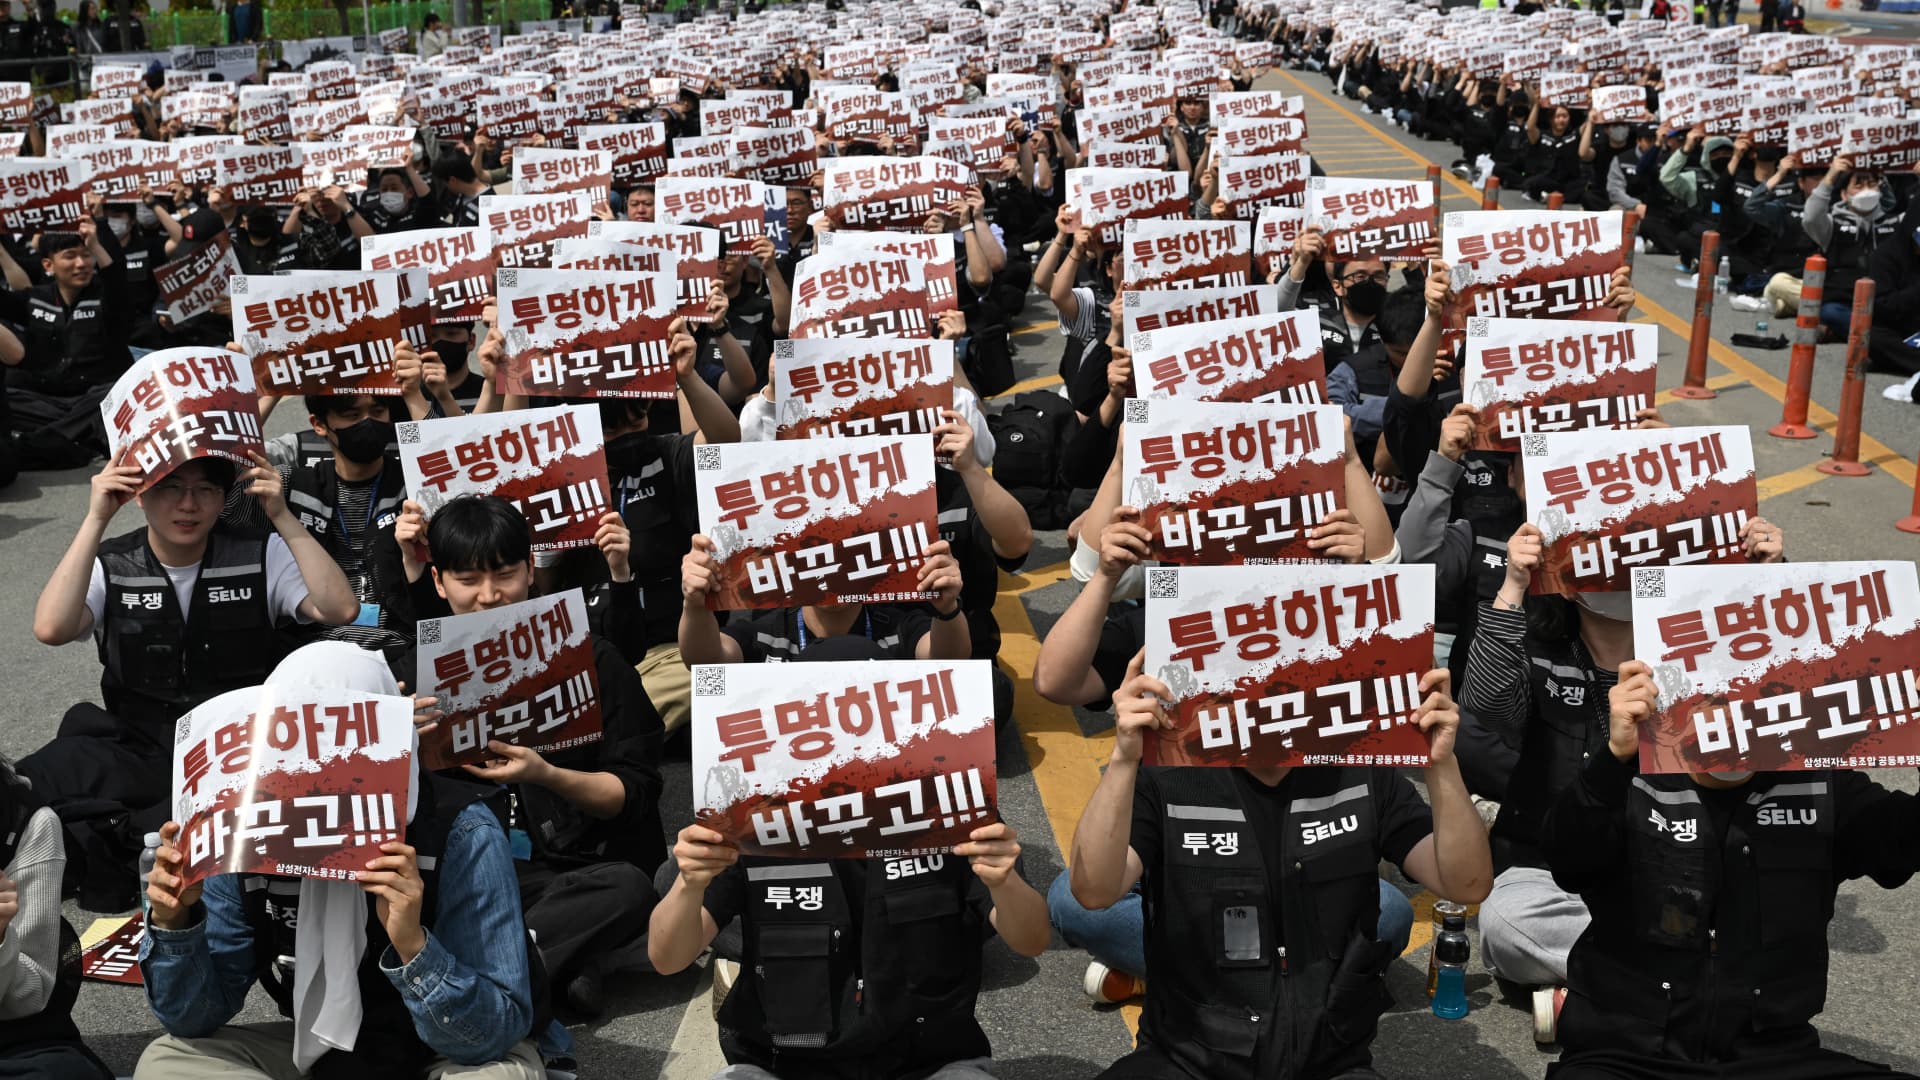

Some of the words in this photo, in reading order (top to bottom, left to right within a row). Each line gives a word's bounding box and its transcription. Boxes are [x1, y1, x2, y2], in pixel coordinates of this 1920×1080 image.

[96, 69, 136, 84] 투명하게
[310, 67, 349, 82] 투명하게
[439, 77, 483, 98] 투명하게
[481, 98, 530, 118] 투명하게
[831, 94, 882, 115] 투명하게
[1114, 82, 1166, 104] 투명하게
[1216, 94, 1273, 118] 투명하게
[80, 100, 126, 122] 투명하게
[240, 101, 285, 122] 투명하게
[705, 105, 761, 125] 투명하게
[1098, 110, 1153, 138] 투명하게
[1749, 101, 1807, 121] 투명하게
[487, 119, 536, 137] 바꾸고!!!
[586, 125, 655, 154] 투명하게
[834, 119, 885, 136] 바꾸고!!!
[1225, 122, 1292, 148] 투명하게
[1795, 118, 1845, 142] 투명하
[1850, 122, 1920, 145] 투명하게
[736, 130, 806, 158] 투명하게
[974, 146, 1003, 166] 고!!!
[1094, 148, 1156, 168] 투명하게
[1855, 149, 1920, 168] 바꾸고!!!
[223, 149, 293, 175] 투명하게
[521, 153, 600, 183] 투명하게
[612, 157, 665, 181] 꾸고!!!
[833, 162, 922, 192] 투명하게
[1226, 159, 1301, 191] 투명하게
[92, 174, 139, 195] 꾸고!!!
[233, 179, 300, 200] 바꾸고!!!
[1090, 176, 1177, 213] 투명하게
[4, 202, 81, 230] 바꾸고!!!
[489, 197, 579, 235] 투명하게
[664, 184, 752, 217] 투명하게
[844, 195, 930, 225] 바꾸고!!!
[1321, 185, 1419, 220] 투명하게
[719, 219, 760, 243] 고!!!
[1262, 218, 1303, 243] 투명
[1334, 221, 1431, 256] 바꾸고!!!
[1457, 216, 1601, 269] 투명하게
[372, 232, 475, 270] 투명하게
[1133, 225, 1237, 268] 투명하게
[559, 253, 660, 272] 명하게
[429, 275, 489, 310] 고!!!
[798, 259, 910, 308] 투명하게
[1475, 273, 1611, 318] 바꾸고!!!
[245, 279, 378, 338] 투명하게
[512, 277, 656, 334] 투명하게
[268, 337, 395, 386] 바꾸고!!!
[531, 339, 670, 386] 바꾸고!!!
[1149, 317, 1300, 396] 투명하게
[1481, 329, 1636, 386] 투명하게
[789, 345, 933, 403] 투명하게
[114, 354, 240, 437] 투명하게
[1498, 393, 1648, 439] 바꾸고!!!
[135, 410, 261, 475] 바꾸고!!!
[416, 411, 580, 493] 투명하게
[1140, 411, 1320, 484] 투명하게
[714, 442, 908, 530] 투명하게
[1543, 432, 1728, 515] 투명하게
[509, 478, 606, 532] 고!!!
[300, 512, 328, 533] 투쟁
[377, 513, 396, 530] SE
[1160, 490, 1337, 552] 바꾸고!!!
[530, 540, 576, 551] 성전자노동조합
[746, 522, 929, 596] 바꾸고!!!
[1571, 510, 1749, 578] 바꾸고!!!
[1483, 553, 1508, 568] 투
[121, 592, 163, 609] 투쟁
[208, 587, 251, 603] SELU
[837, 592, 894, 603] 삼성전자노동조합
[1168, 573, 1402, 672] 투명하게
[1657, 570, 1893, 673] 투명하게
[433, 598, 574, 696] 투명하게
[1545, 677, 1585, 706] 투쟁
[452, 670, 594, 753] 바꾸고!!!
[716, 668, 958, 773] 투명하게
[1198, 672, 1421, 755] 바꾸고!!!
[1693, 669, 1920, 760] 바꾸고!!!
[181, 701, 379, 797] 투명하게
[1303, 754, 1373, 765] 삼성전자노동조합
[1375, 754, 1428, 765] 공동투쟁본부
[1804, 757, 1877, 768] 삼성전자노동조합
[752, 768, 988, 848] 바꾸고!!!
[190, 794, 396, 867] 바꾸고!!!
[1182, 832, 1239, 855] 투쟁
[1302, 815, 1358, 845] SELU
[1649, 809, 1697, 842] 투쟁
[1757, 808, 1816, 826] SELU
[865, 848, 937, 858] 삼성전자노동조합
[276, 863, 346, 880] 삼성전자노동조합
[764, 886, 823, 910] 투쟁
[885, 854, 944, 880] SELU
